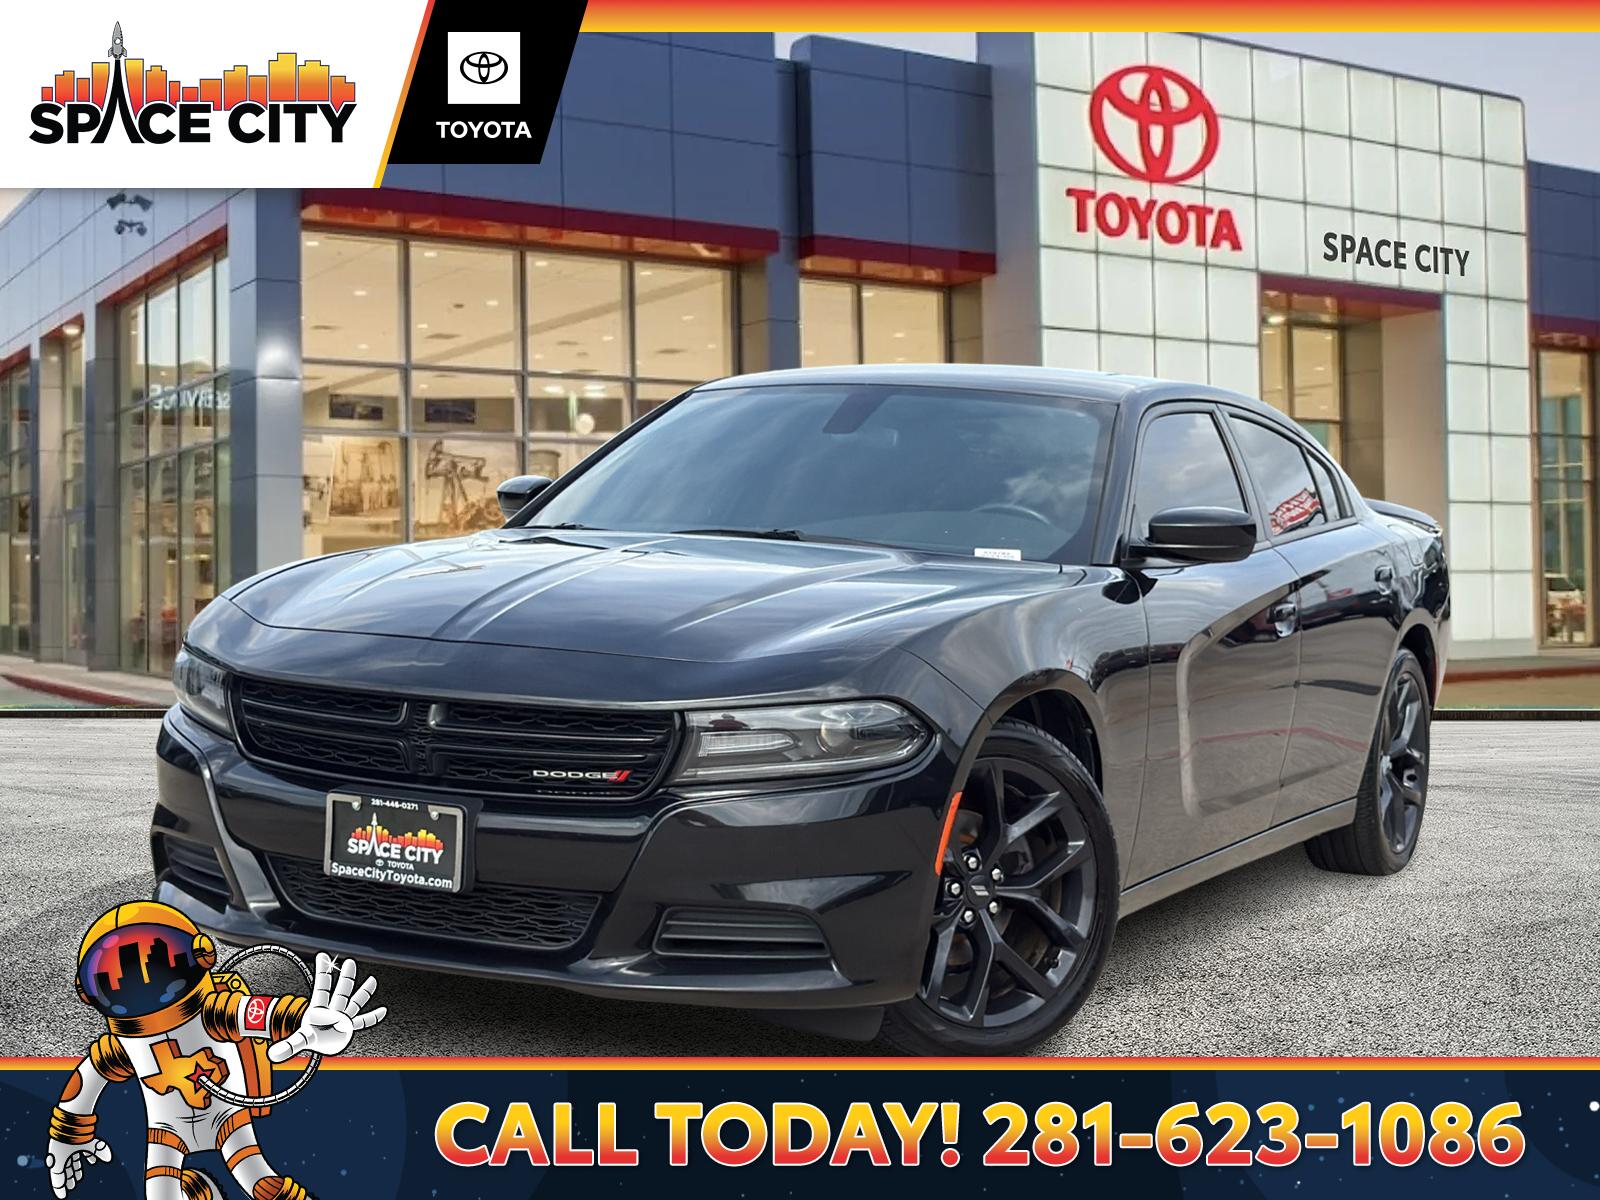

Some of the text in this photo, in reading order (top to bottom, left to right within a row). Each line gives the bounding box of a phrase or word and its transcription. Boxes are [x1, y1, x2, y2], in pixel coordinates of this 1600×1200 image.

[1066, 187, 1242, 251] TOYOTA
[1323, 231, 1470, 277] SPACE CITY
[532, 769, 617, 780] DODGE
[347, 824, 444, 865] SPACE CITY
[331, 862, 453, 888] SpaceCityToyota.com
[387, 860, 415, 871] TOYOTA
